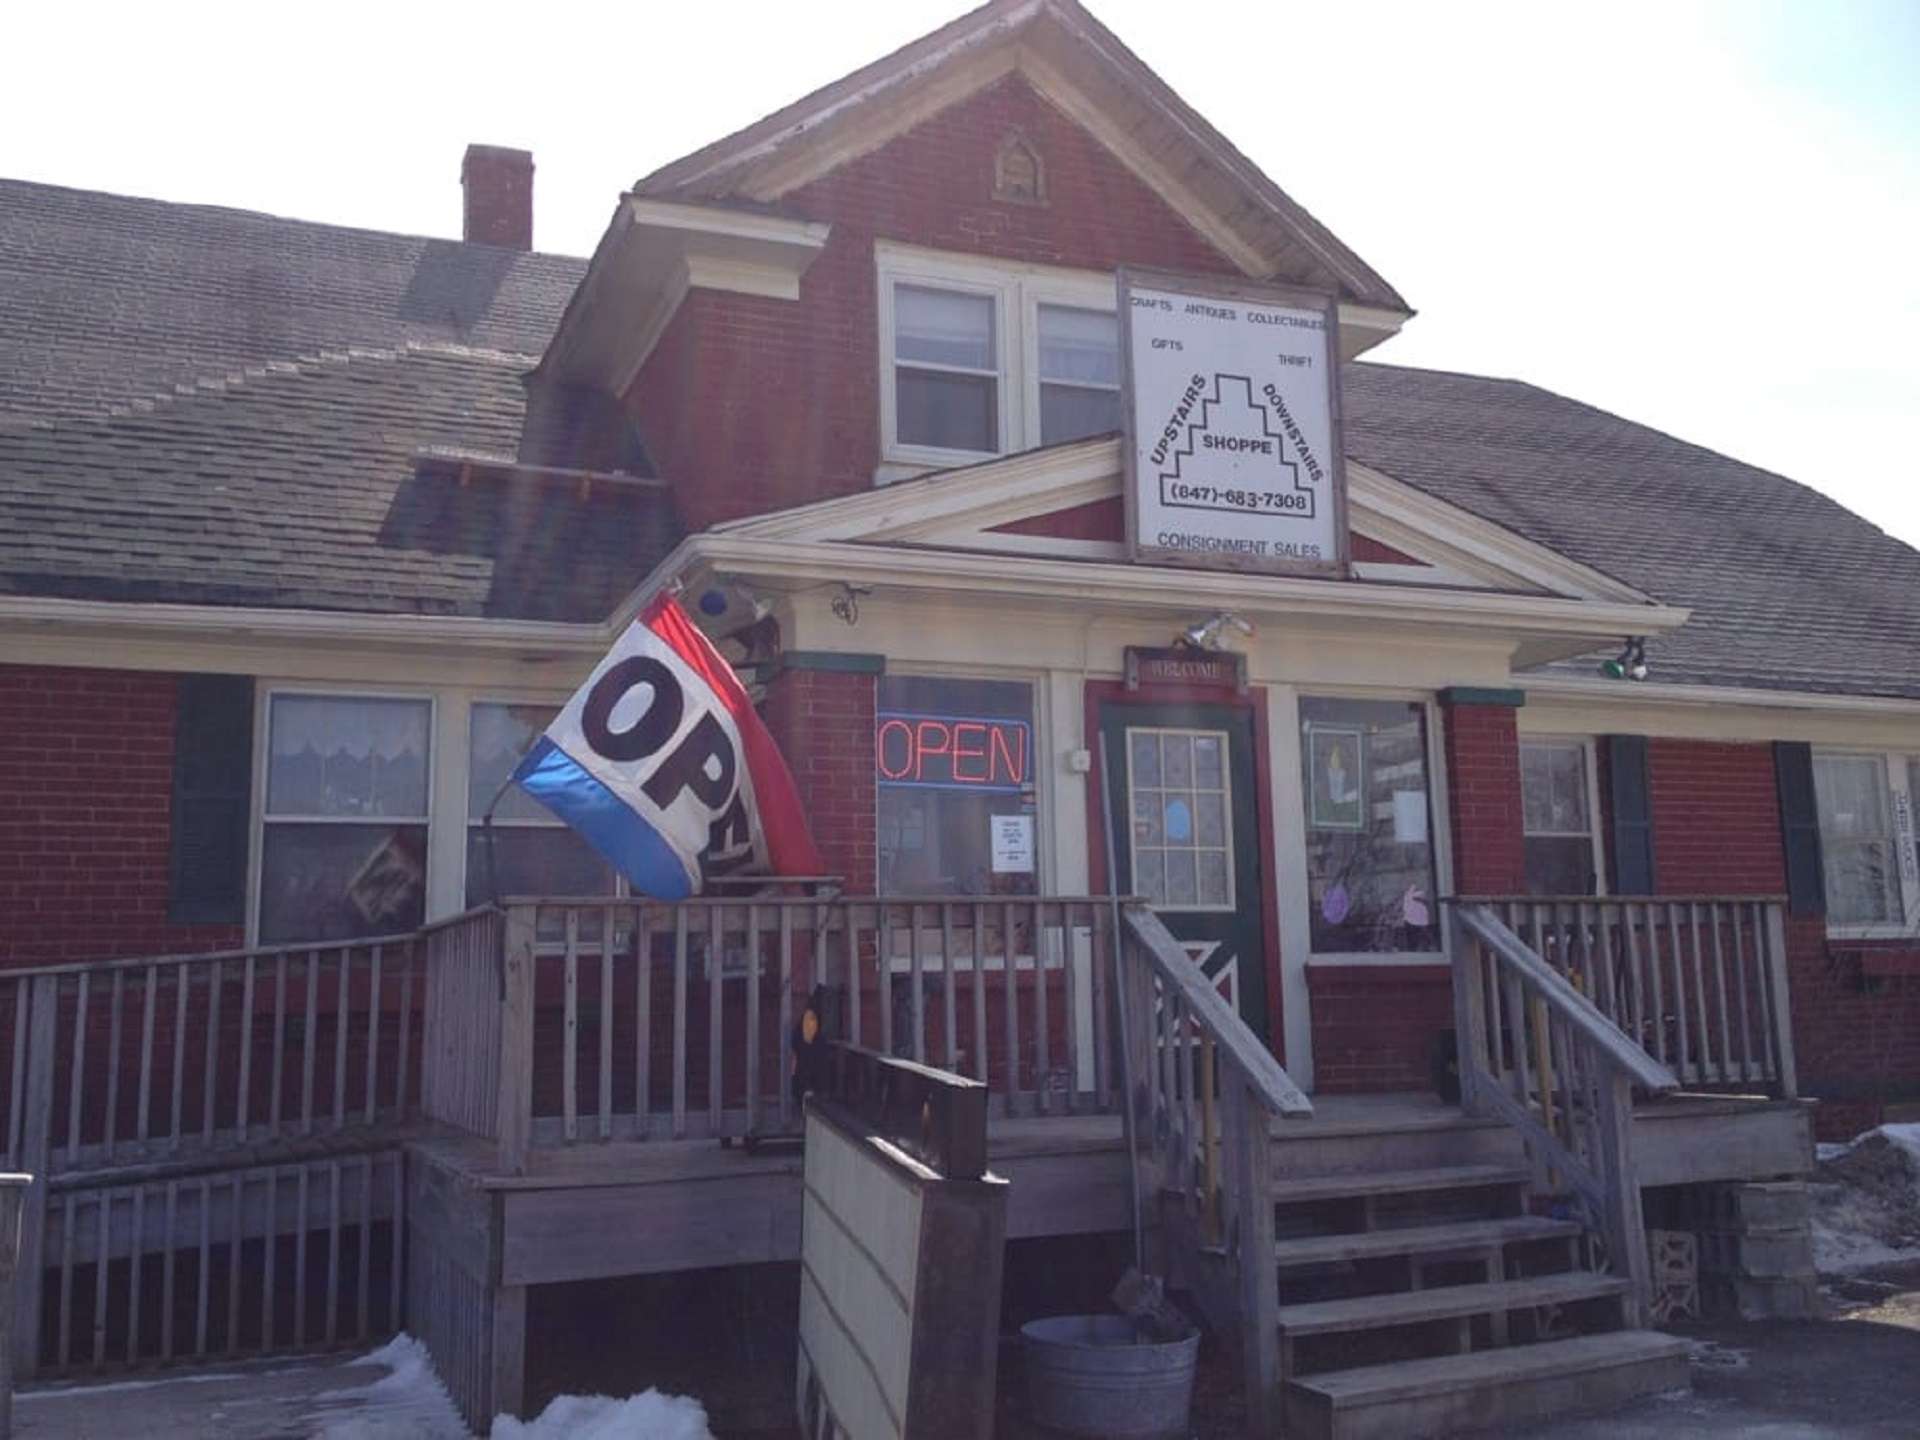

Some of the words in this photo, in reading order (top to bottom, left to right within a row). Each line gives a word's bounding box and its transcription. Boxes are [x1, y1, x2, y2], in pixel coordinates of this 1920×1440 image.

[1130, 297, 1173, 312] CRAFTS
[1185, 304, 1237, 320] ANTIQUES
[1151, 338, 1184, 352] GIFTS
[1279, 354, 1312, 369] THRIFT
[1150, 373, 1207, 466] UPSTAIRS
[1263, 383, 1323, 482] DOWNSTAIRS
[1202, 434, 1273, 455] SHOPPE
[1171, 483, 1307, 510] (847)-683-7308
[1158, 532, 1269, 555] CONSIGNMENT
[1274, 541, 1321, 559] SALES
[878, 719, 1025, 784] OPEN
